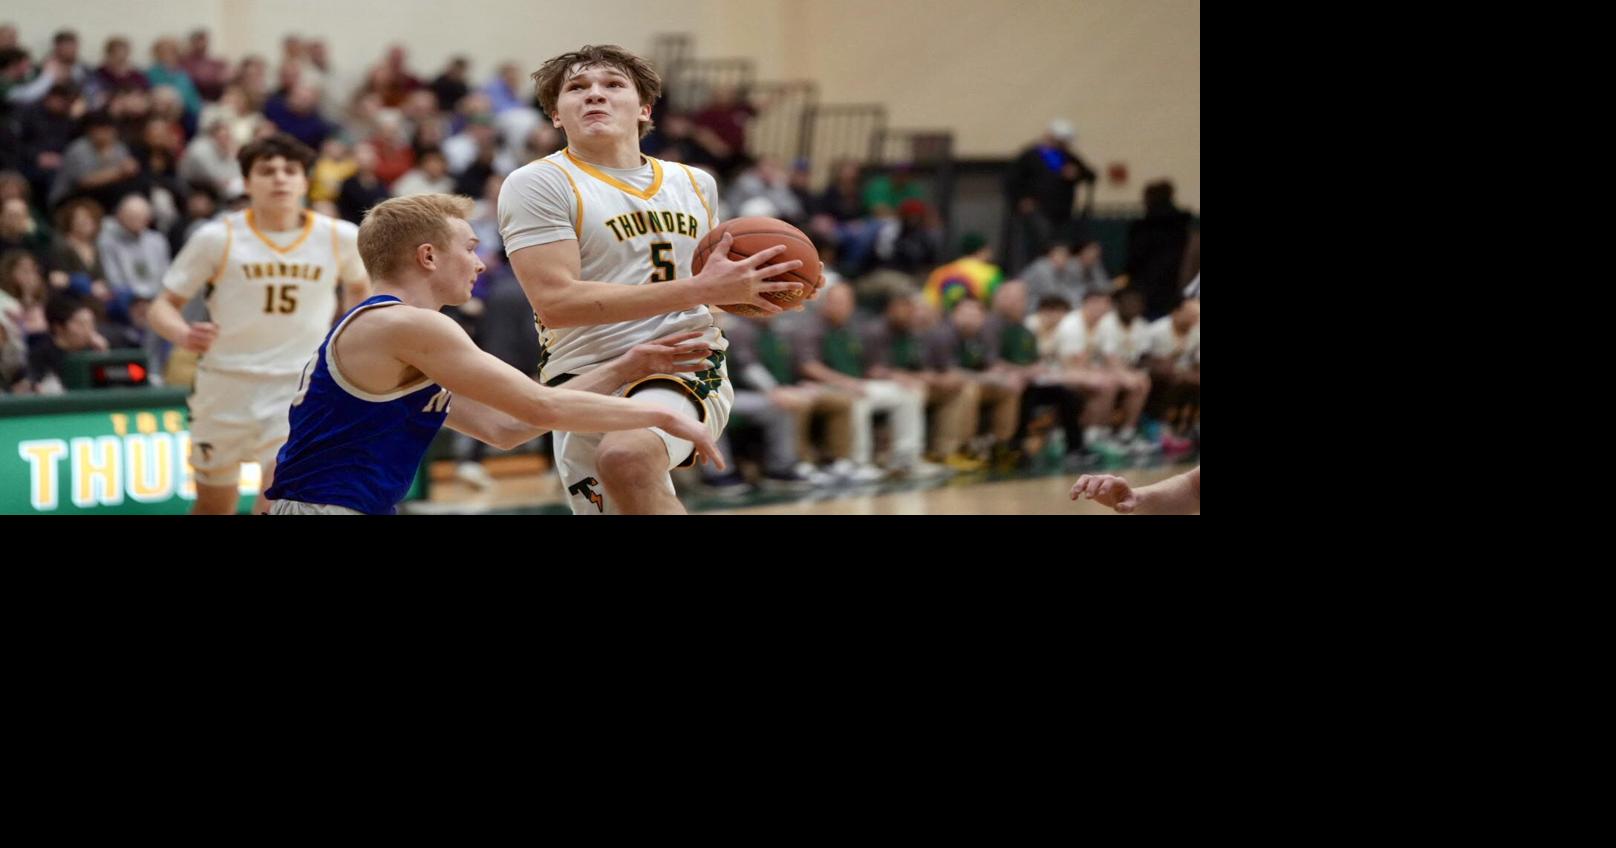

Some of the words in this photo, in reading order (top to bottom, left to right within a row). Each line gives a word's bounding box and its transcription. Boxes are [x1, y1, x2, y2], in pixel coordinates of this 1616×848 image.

[604, 210, 698, 243] THUNDER
[649, 241, 676, 283] 5
[262, 283, 299, 316] 15
